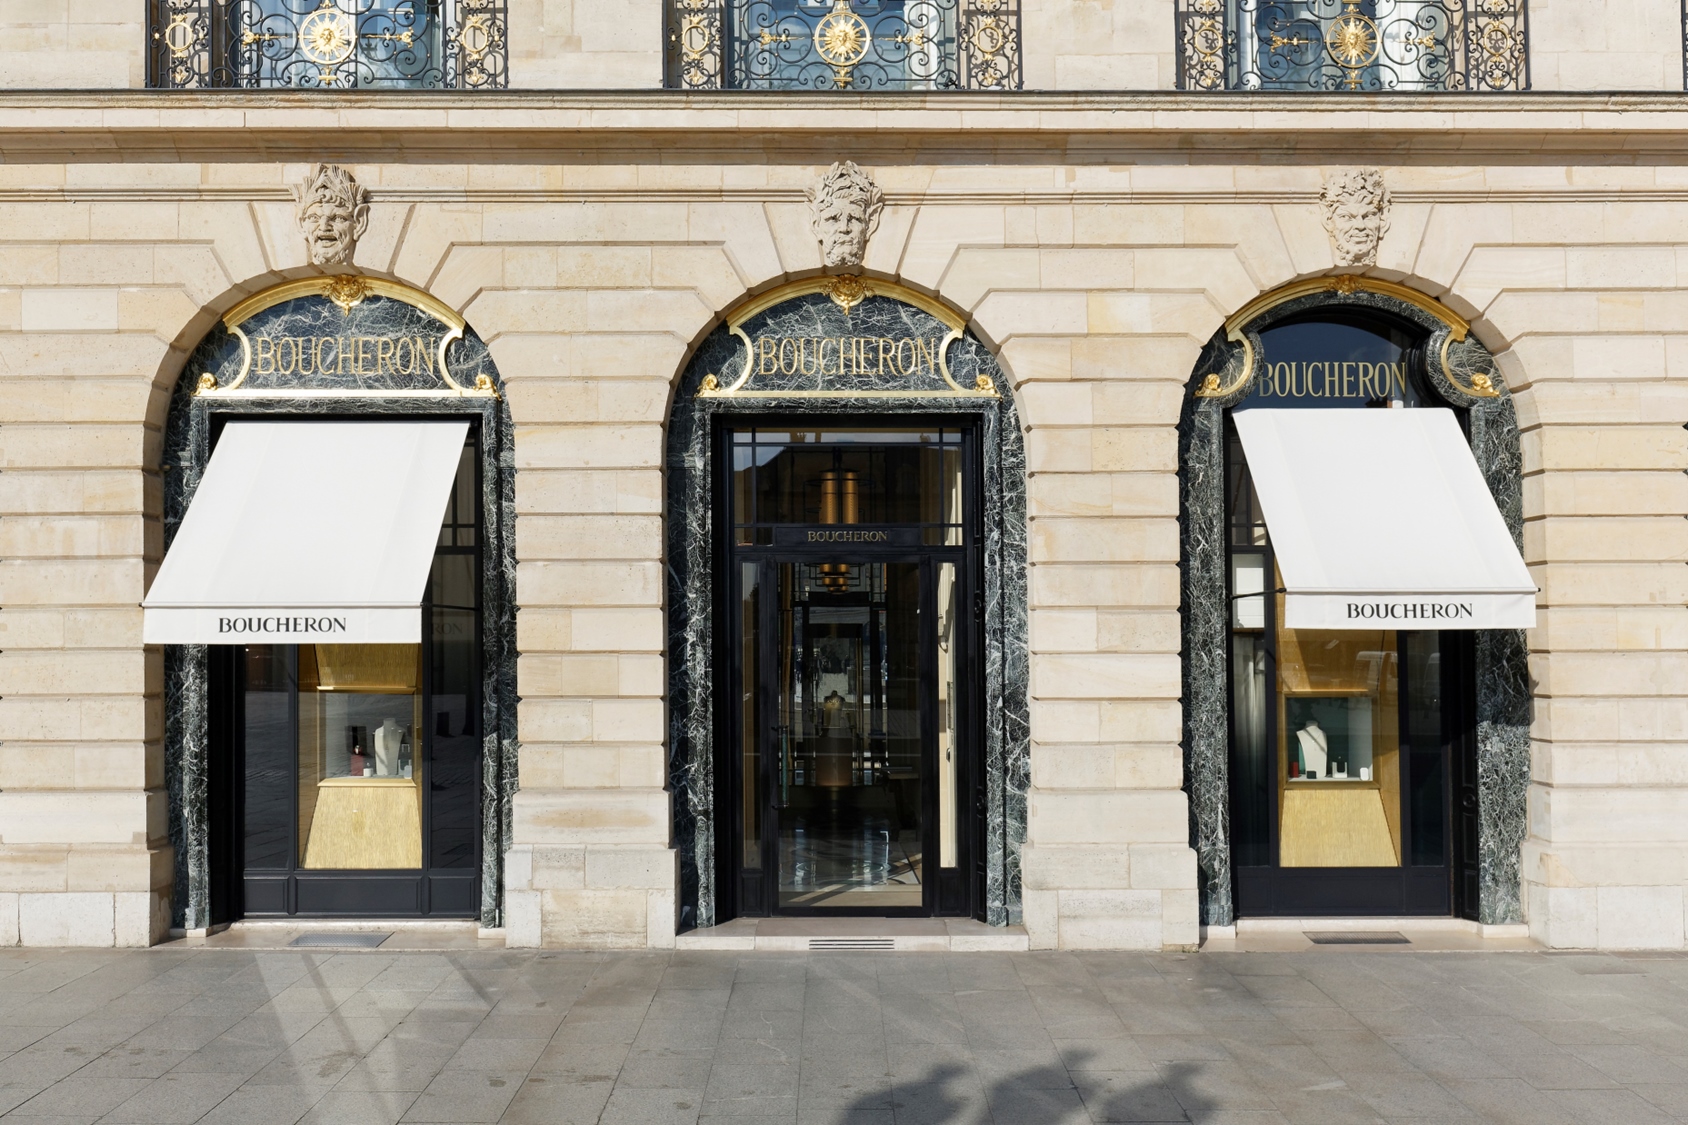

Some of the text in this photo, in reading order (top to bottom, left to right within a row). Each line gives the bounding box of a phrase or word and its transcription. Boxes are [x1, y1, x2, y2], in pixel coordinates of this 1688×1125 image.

[257, 337, 435, 375] BOUCHERON
[759, 337, 935, 376] BOUCHERON
[1259, 361, 1406, 399] BOUCHERON
[807, 530, 888, 542] BOUCHERON
[1347, 603, 1473, 619] BOUCHERON
[218, 617, 346, 633] BOUCHERON
